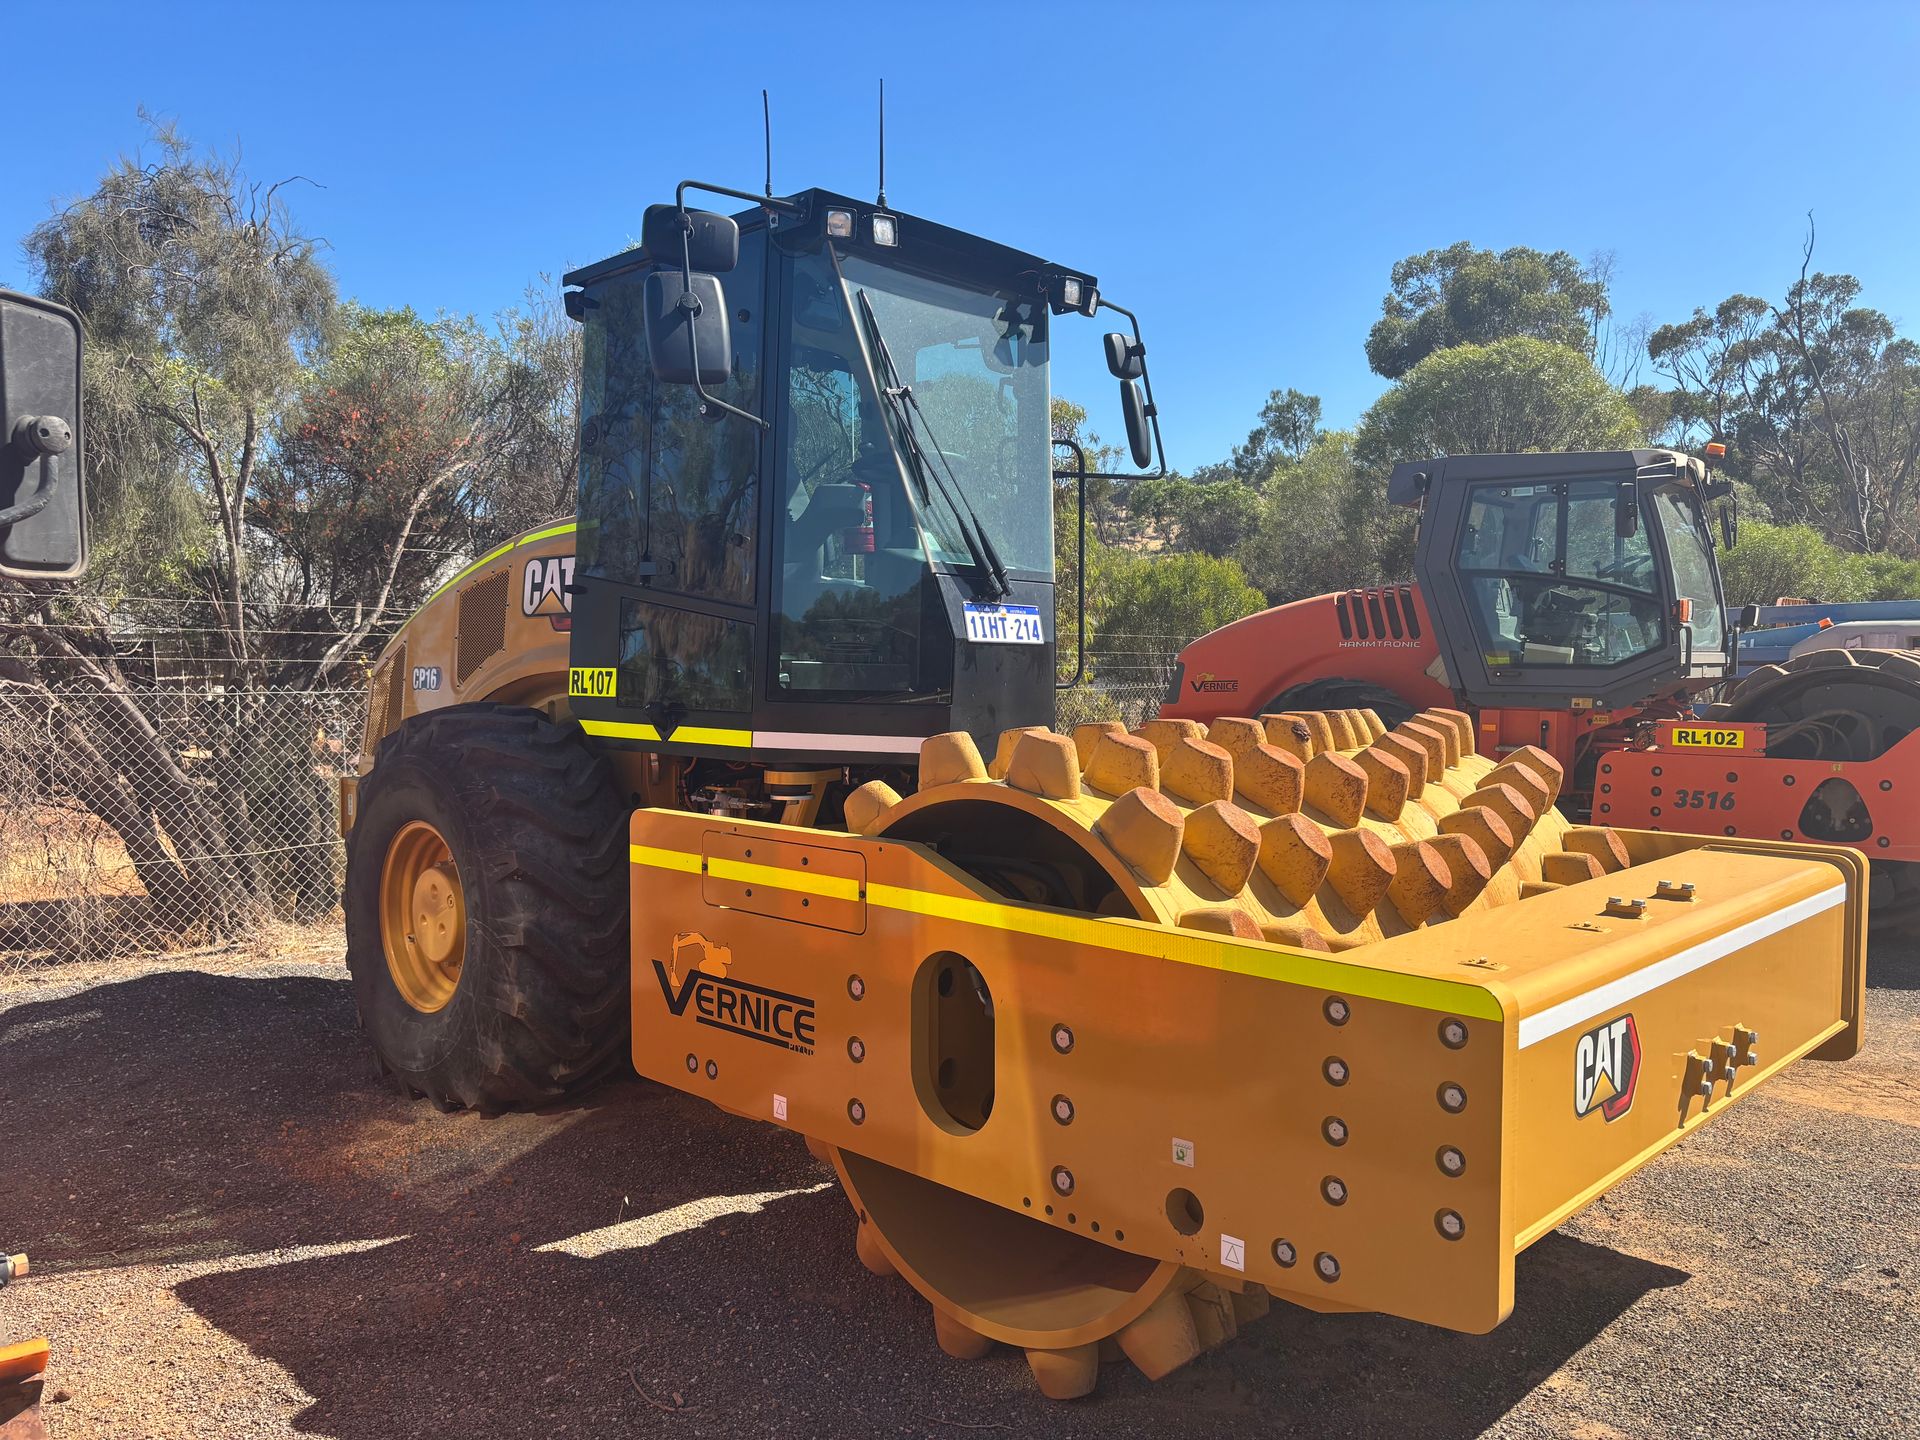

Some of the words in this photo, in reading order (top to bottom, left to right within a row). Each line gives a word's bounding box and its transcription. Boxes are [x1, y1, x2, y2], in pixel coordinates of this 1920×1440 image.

[524, 558, 575, 615] CAT
[1338, 641, 1421, 649] HAMMTRONIC
[413, 667, 438, 690] CP16
[570, 669, 614, 696] RL107
[1190, 680, 1239, 693] VERNICE
[1677, 730, 1738, 746] RL102
[1673, 789, 1736, 811] 3516
[651, 958, 815, 1046] VERNICE
[1576, 1017, 1627, 1114] CAT
